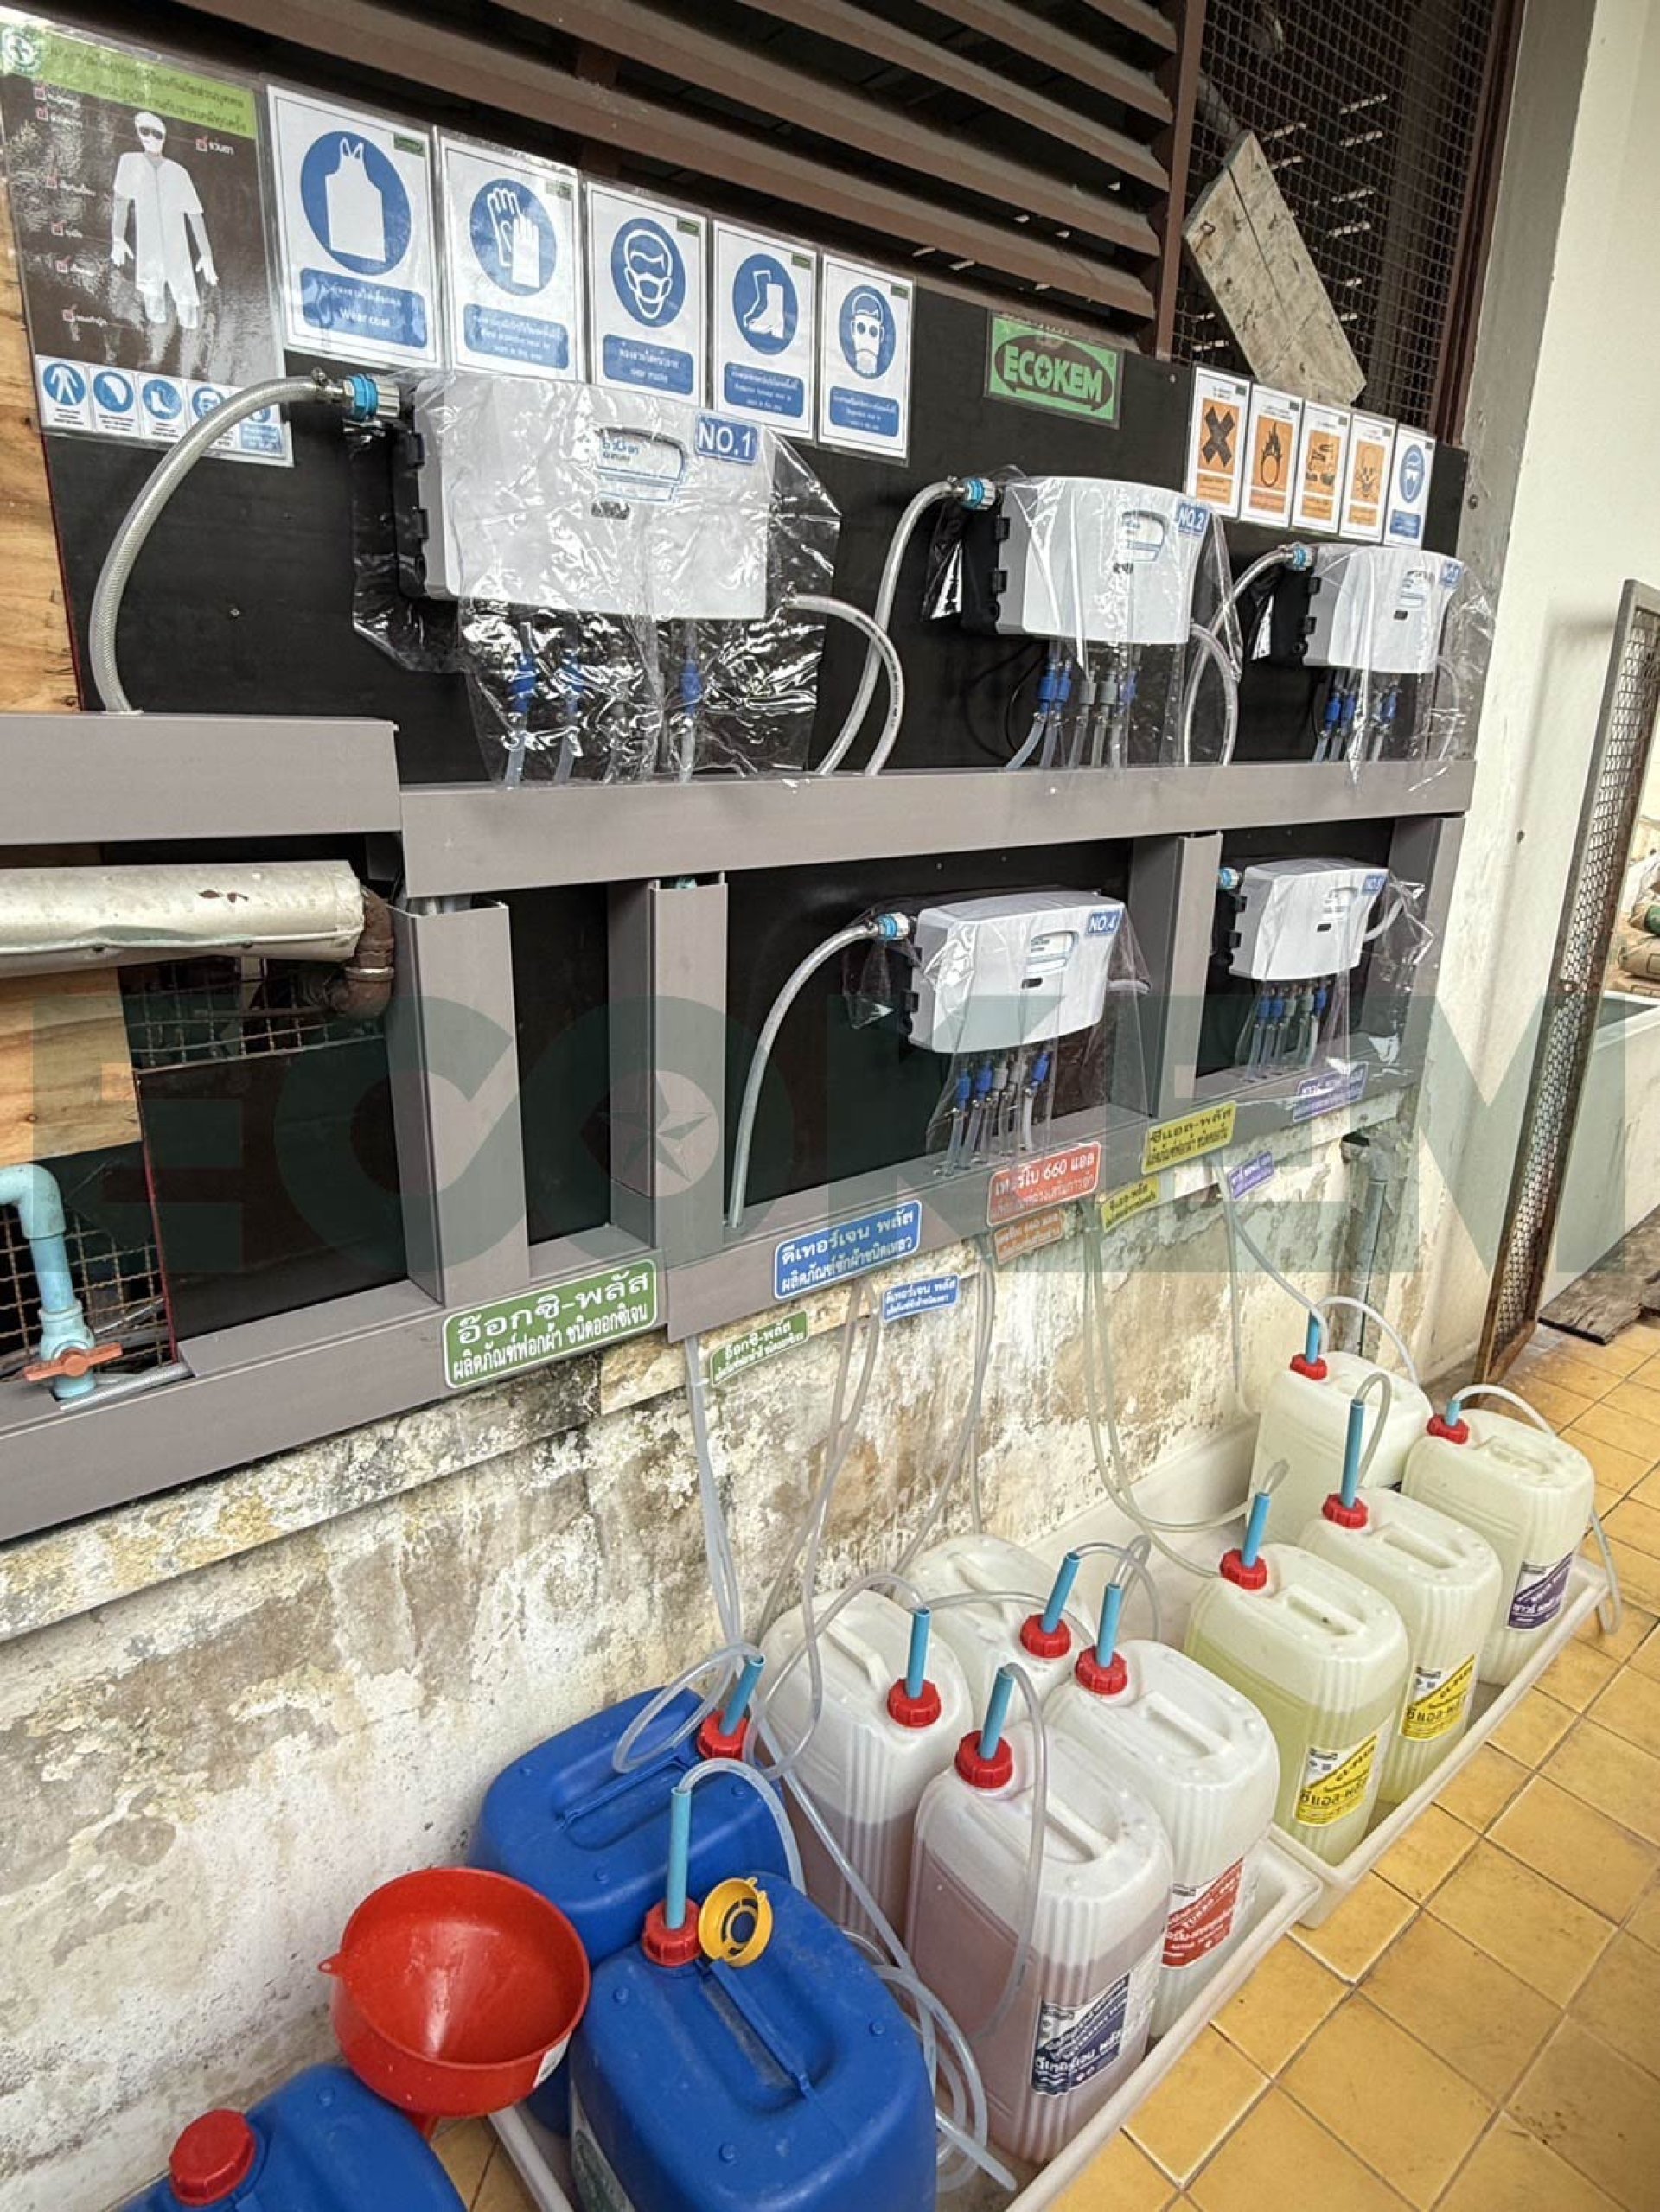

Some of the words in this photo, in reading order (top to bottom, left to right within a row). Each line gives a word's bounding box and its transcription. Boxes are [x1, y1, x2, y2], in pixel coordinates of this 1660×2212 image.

[1003, 344, 1104, 404] ECOKEM
[698, 421, 752, 458] NO.1
[1178, 506, 1205, 531] NO.2
[1043, 1159, 1068, 1181] 660
[782, 1224, 871, 1265] ดีเทอร์เจน
[876, 1209, 915, 1235] พลัส
